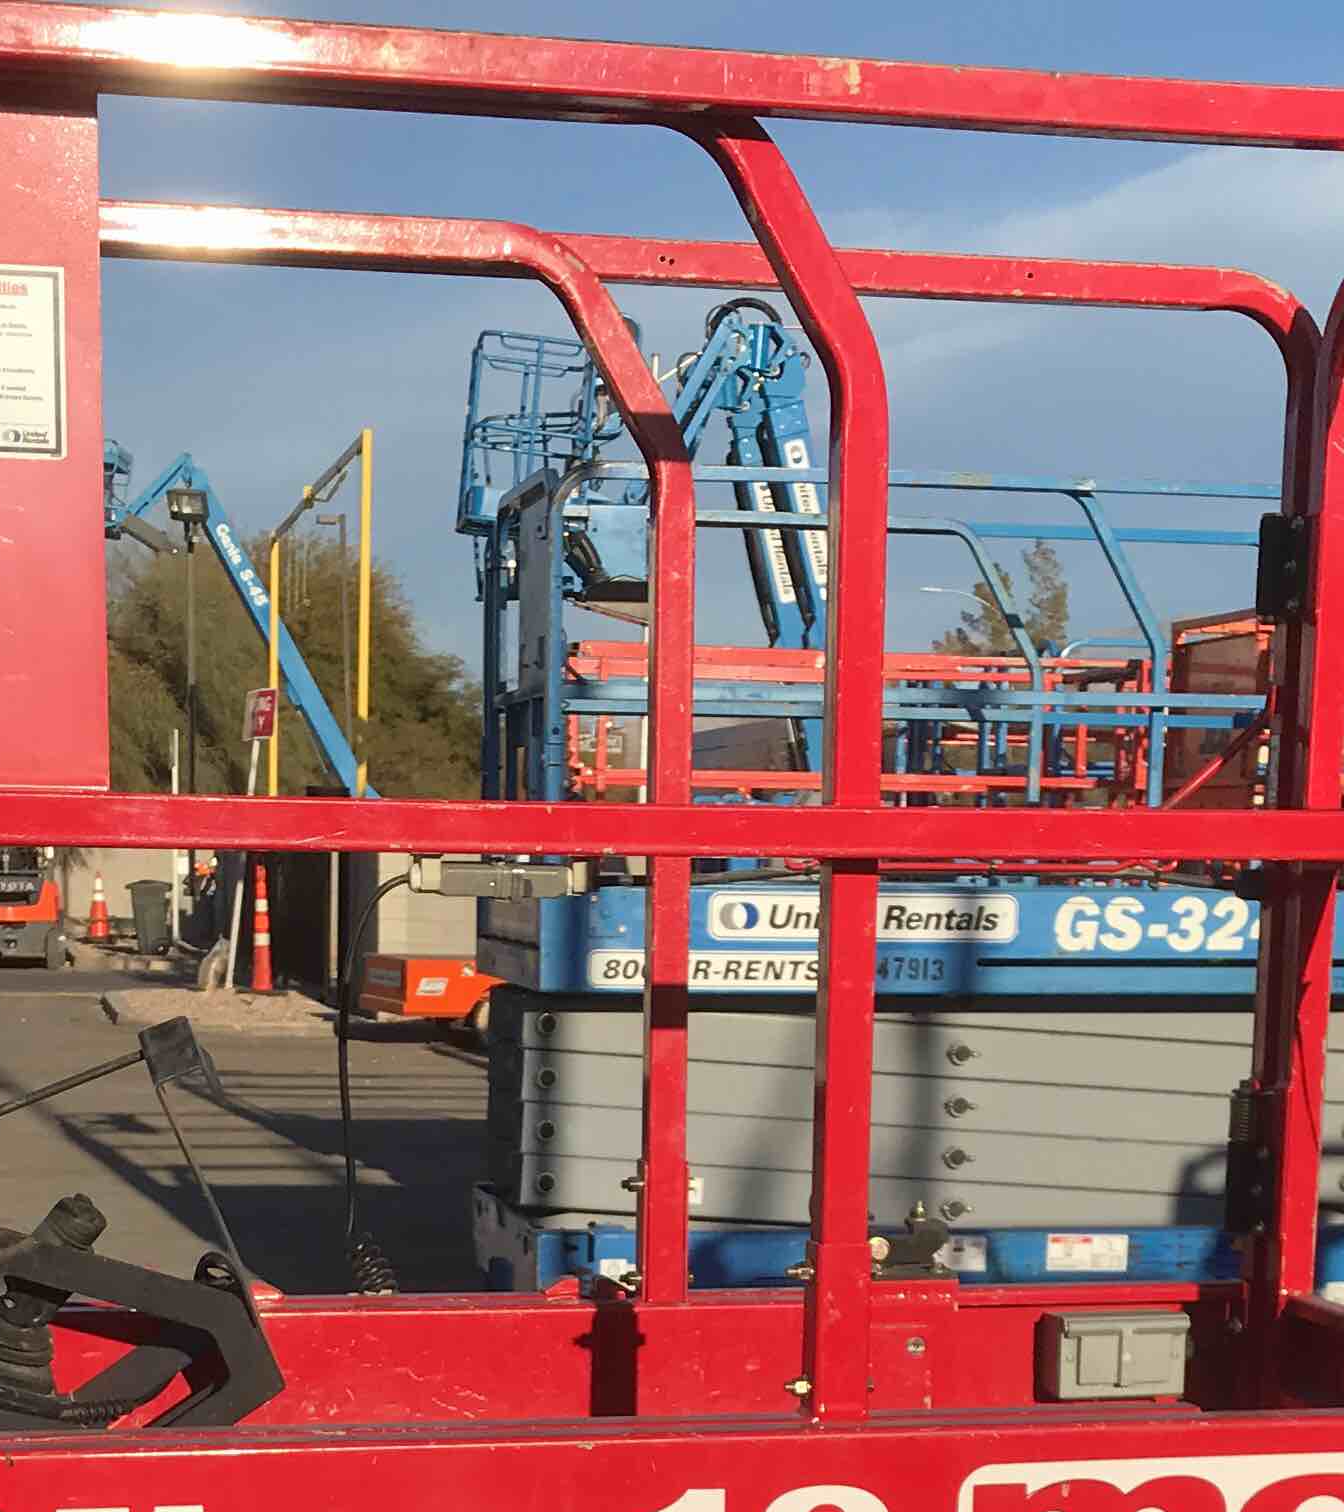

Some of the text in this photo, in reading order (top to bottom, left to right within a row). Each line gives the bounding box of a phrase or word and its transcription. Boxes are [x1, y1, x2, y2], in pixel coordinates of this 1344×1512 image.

[768, 903, 1000, 933] Uni Rentals
[1053, 895, 1260, 954] GS-32
